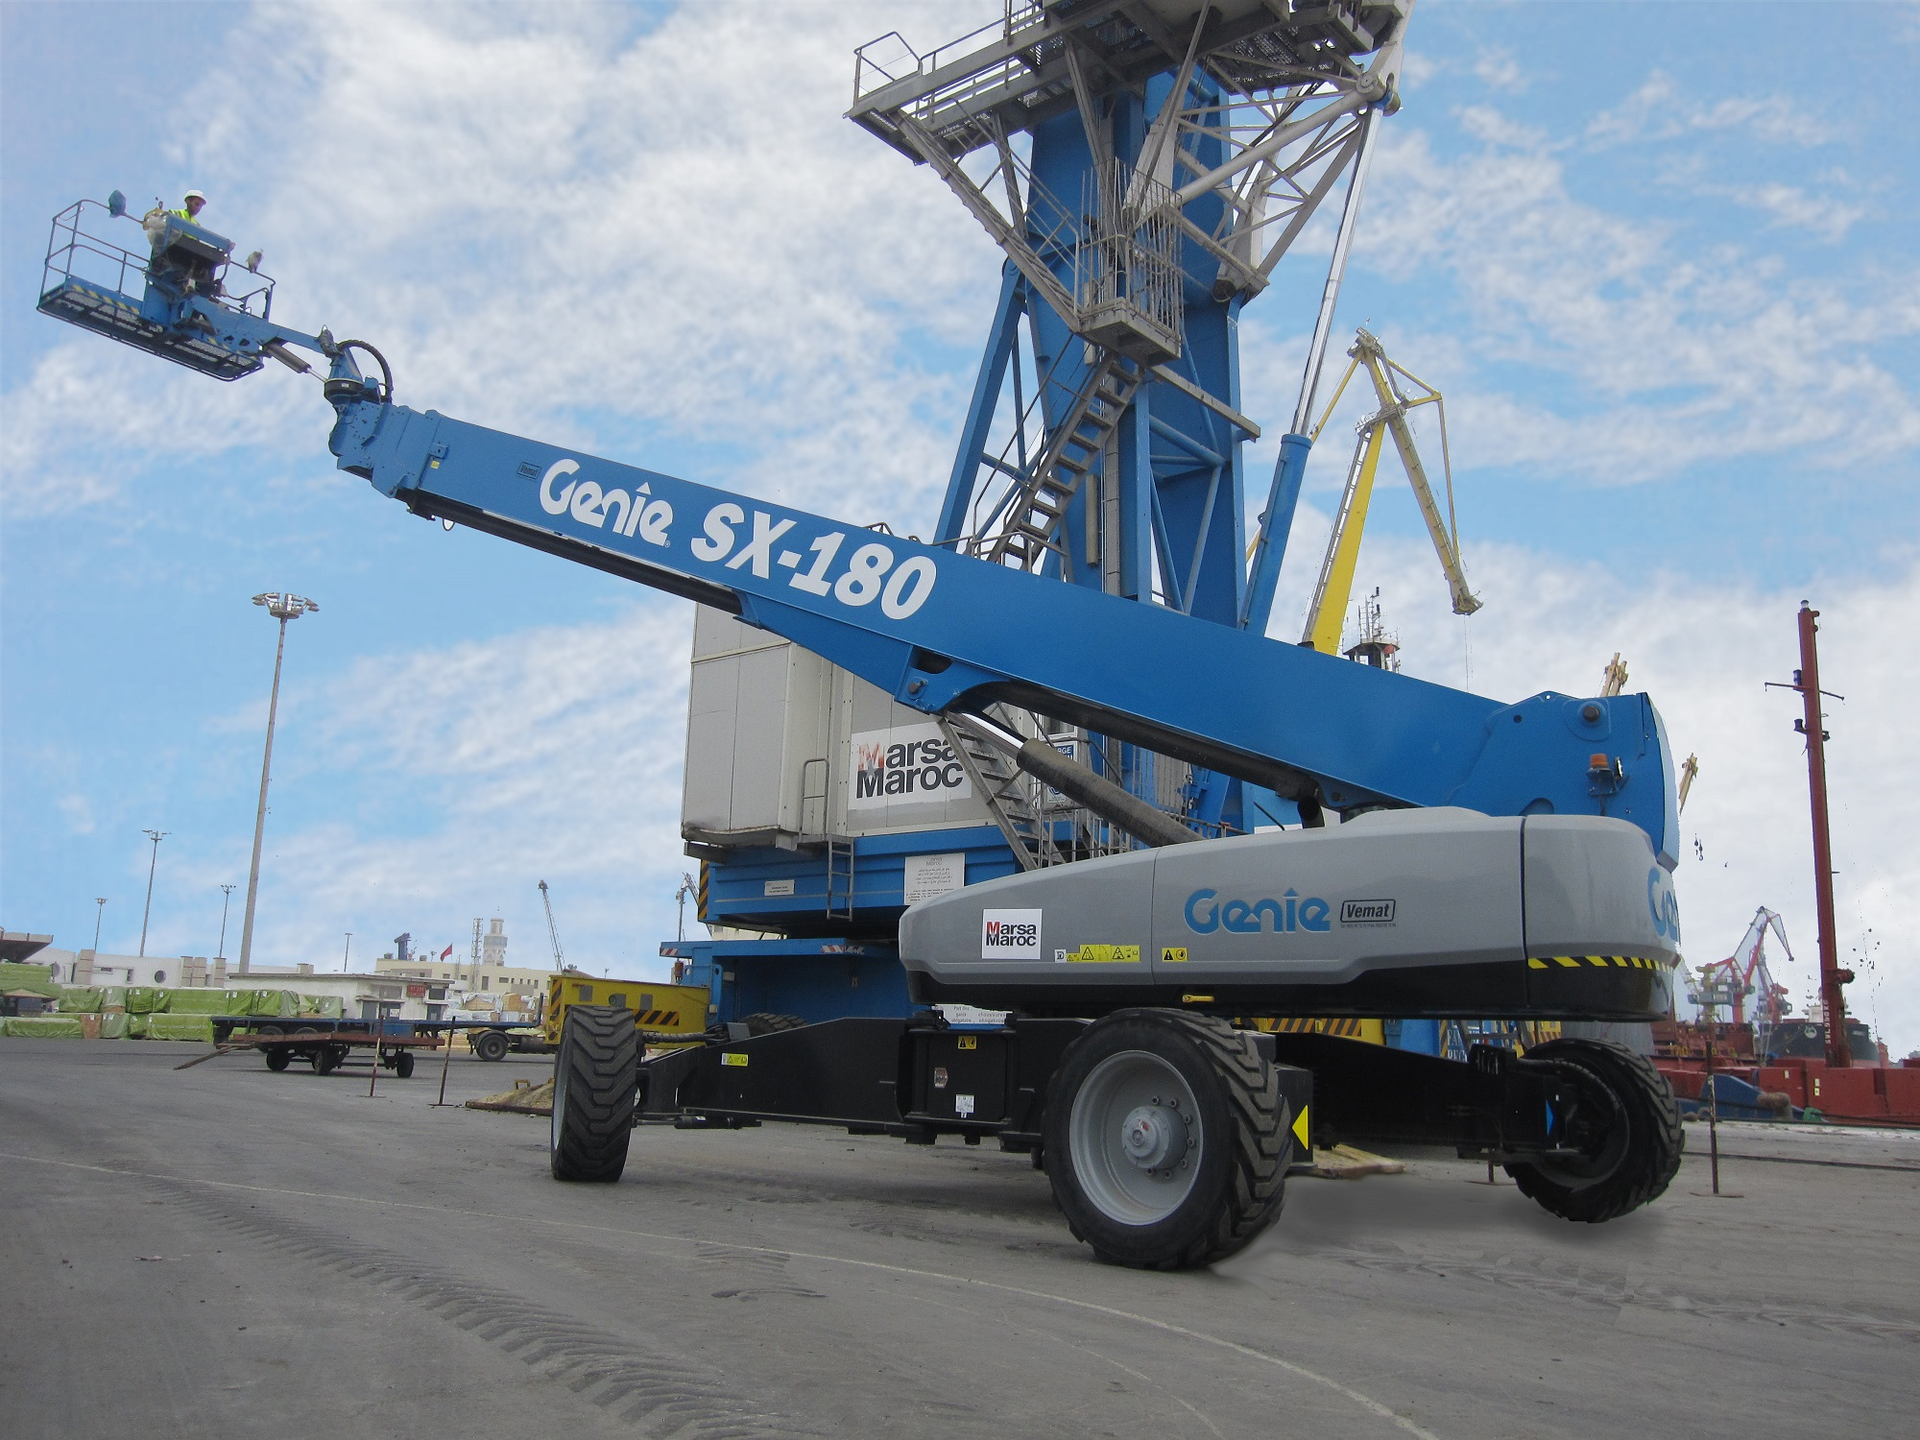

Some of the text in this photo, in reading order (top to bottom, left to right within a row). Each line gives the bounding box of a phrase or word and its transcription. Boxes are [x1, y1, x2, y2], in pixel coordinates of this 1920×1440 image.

[539, 458, 937, 620] Genie SX-180
[856, 762, 964, 799] Maroc
[1184, 887, 1331, 935] Genie
[1347, 903, 1389, 918] Vemat
[986, 921, 1037, 935] Marsa
[986, 933, 1037, 946] Maroc
